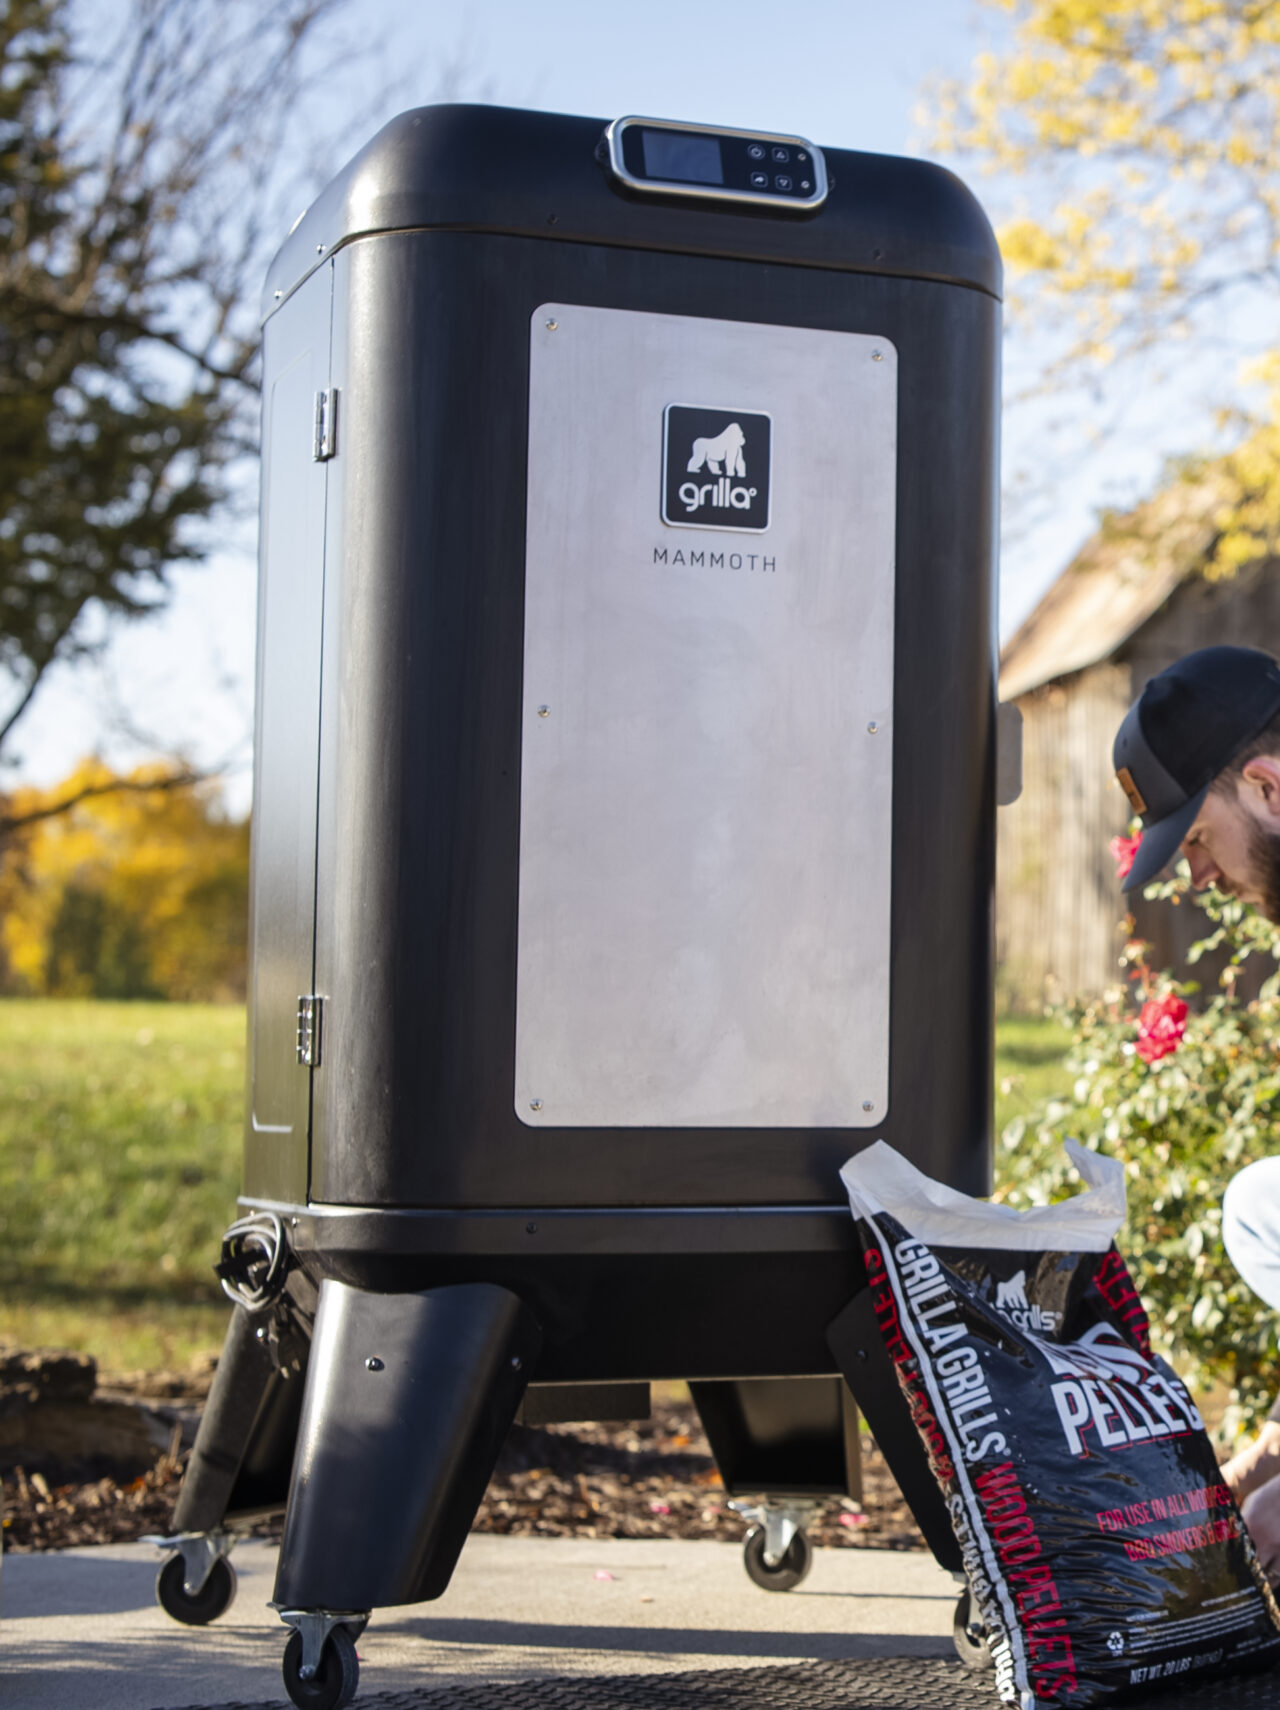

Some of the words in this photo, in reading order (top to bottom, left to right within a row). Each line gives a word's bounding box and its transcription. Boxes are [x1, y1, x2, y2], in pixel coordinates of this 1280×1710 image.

[653, 547, 776, 572] MAMMOTH
[895, 1238, 968, 1354] GRILLA
[936, 1346, 1007, 1462] GRILLS
[975, 1461, 1041, 1566] WOOD
[1009, 1565, 1079, 1698] PELLETS
[1096, 1508, 1128, 1534] FOR
[1124, 1502, 1153, 1527] USE
[1150, 1498, 1168, 1521] IN
[1166, 1494, 1190, 1517] ALL
[1124, 1537, 1157, 1562] BBQ
[1153, 1525, 1208, 1556] SMOKERS
[1130, 1666, 1149, 1685] NET
